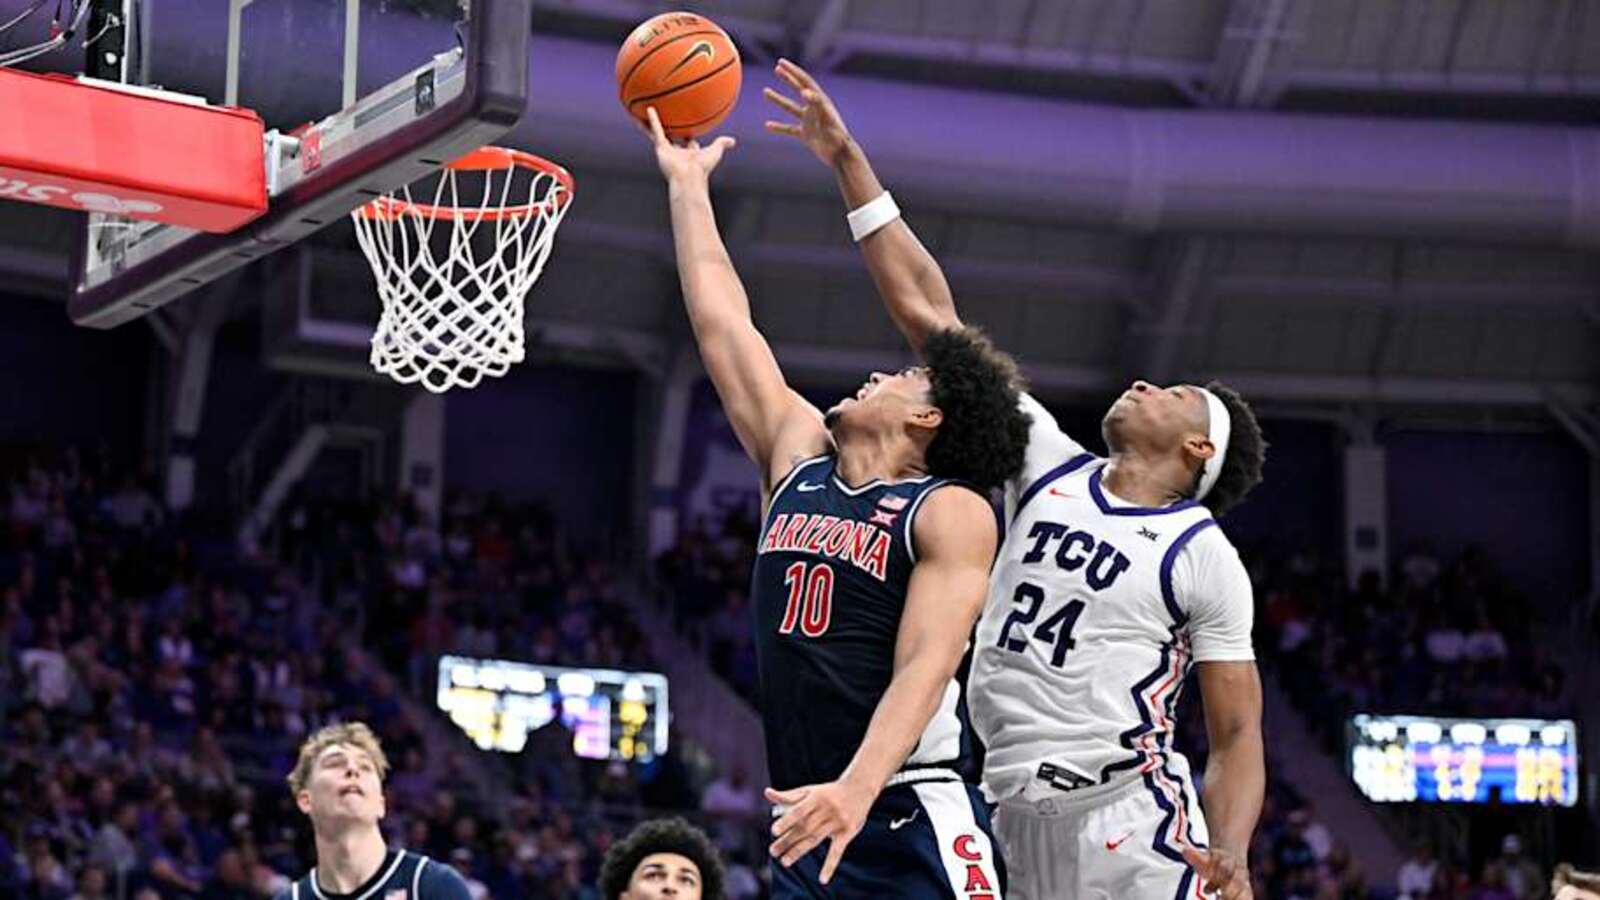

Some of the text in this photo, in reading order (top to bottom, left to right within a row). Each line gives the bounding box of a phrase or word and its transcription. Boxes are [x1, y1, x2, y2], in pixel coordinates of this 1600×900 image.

[760, 513, 892, 582] ARIZONA
[1021, 520, 1131, 592] TCU
[778, 560, 835, 638] 10
[996, 581, 1086, 669] 24
[953, 834, 996, 900] CA
